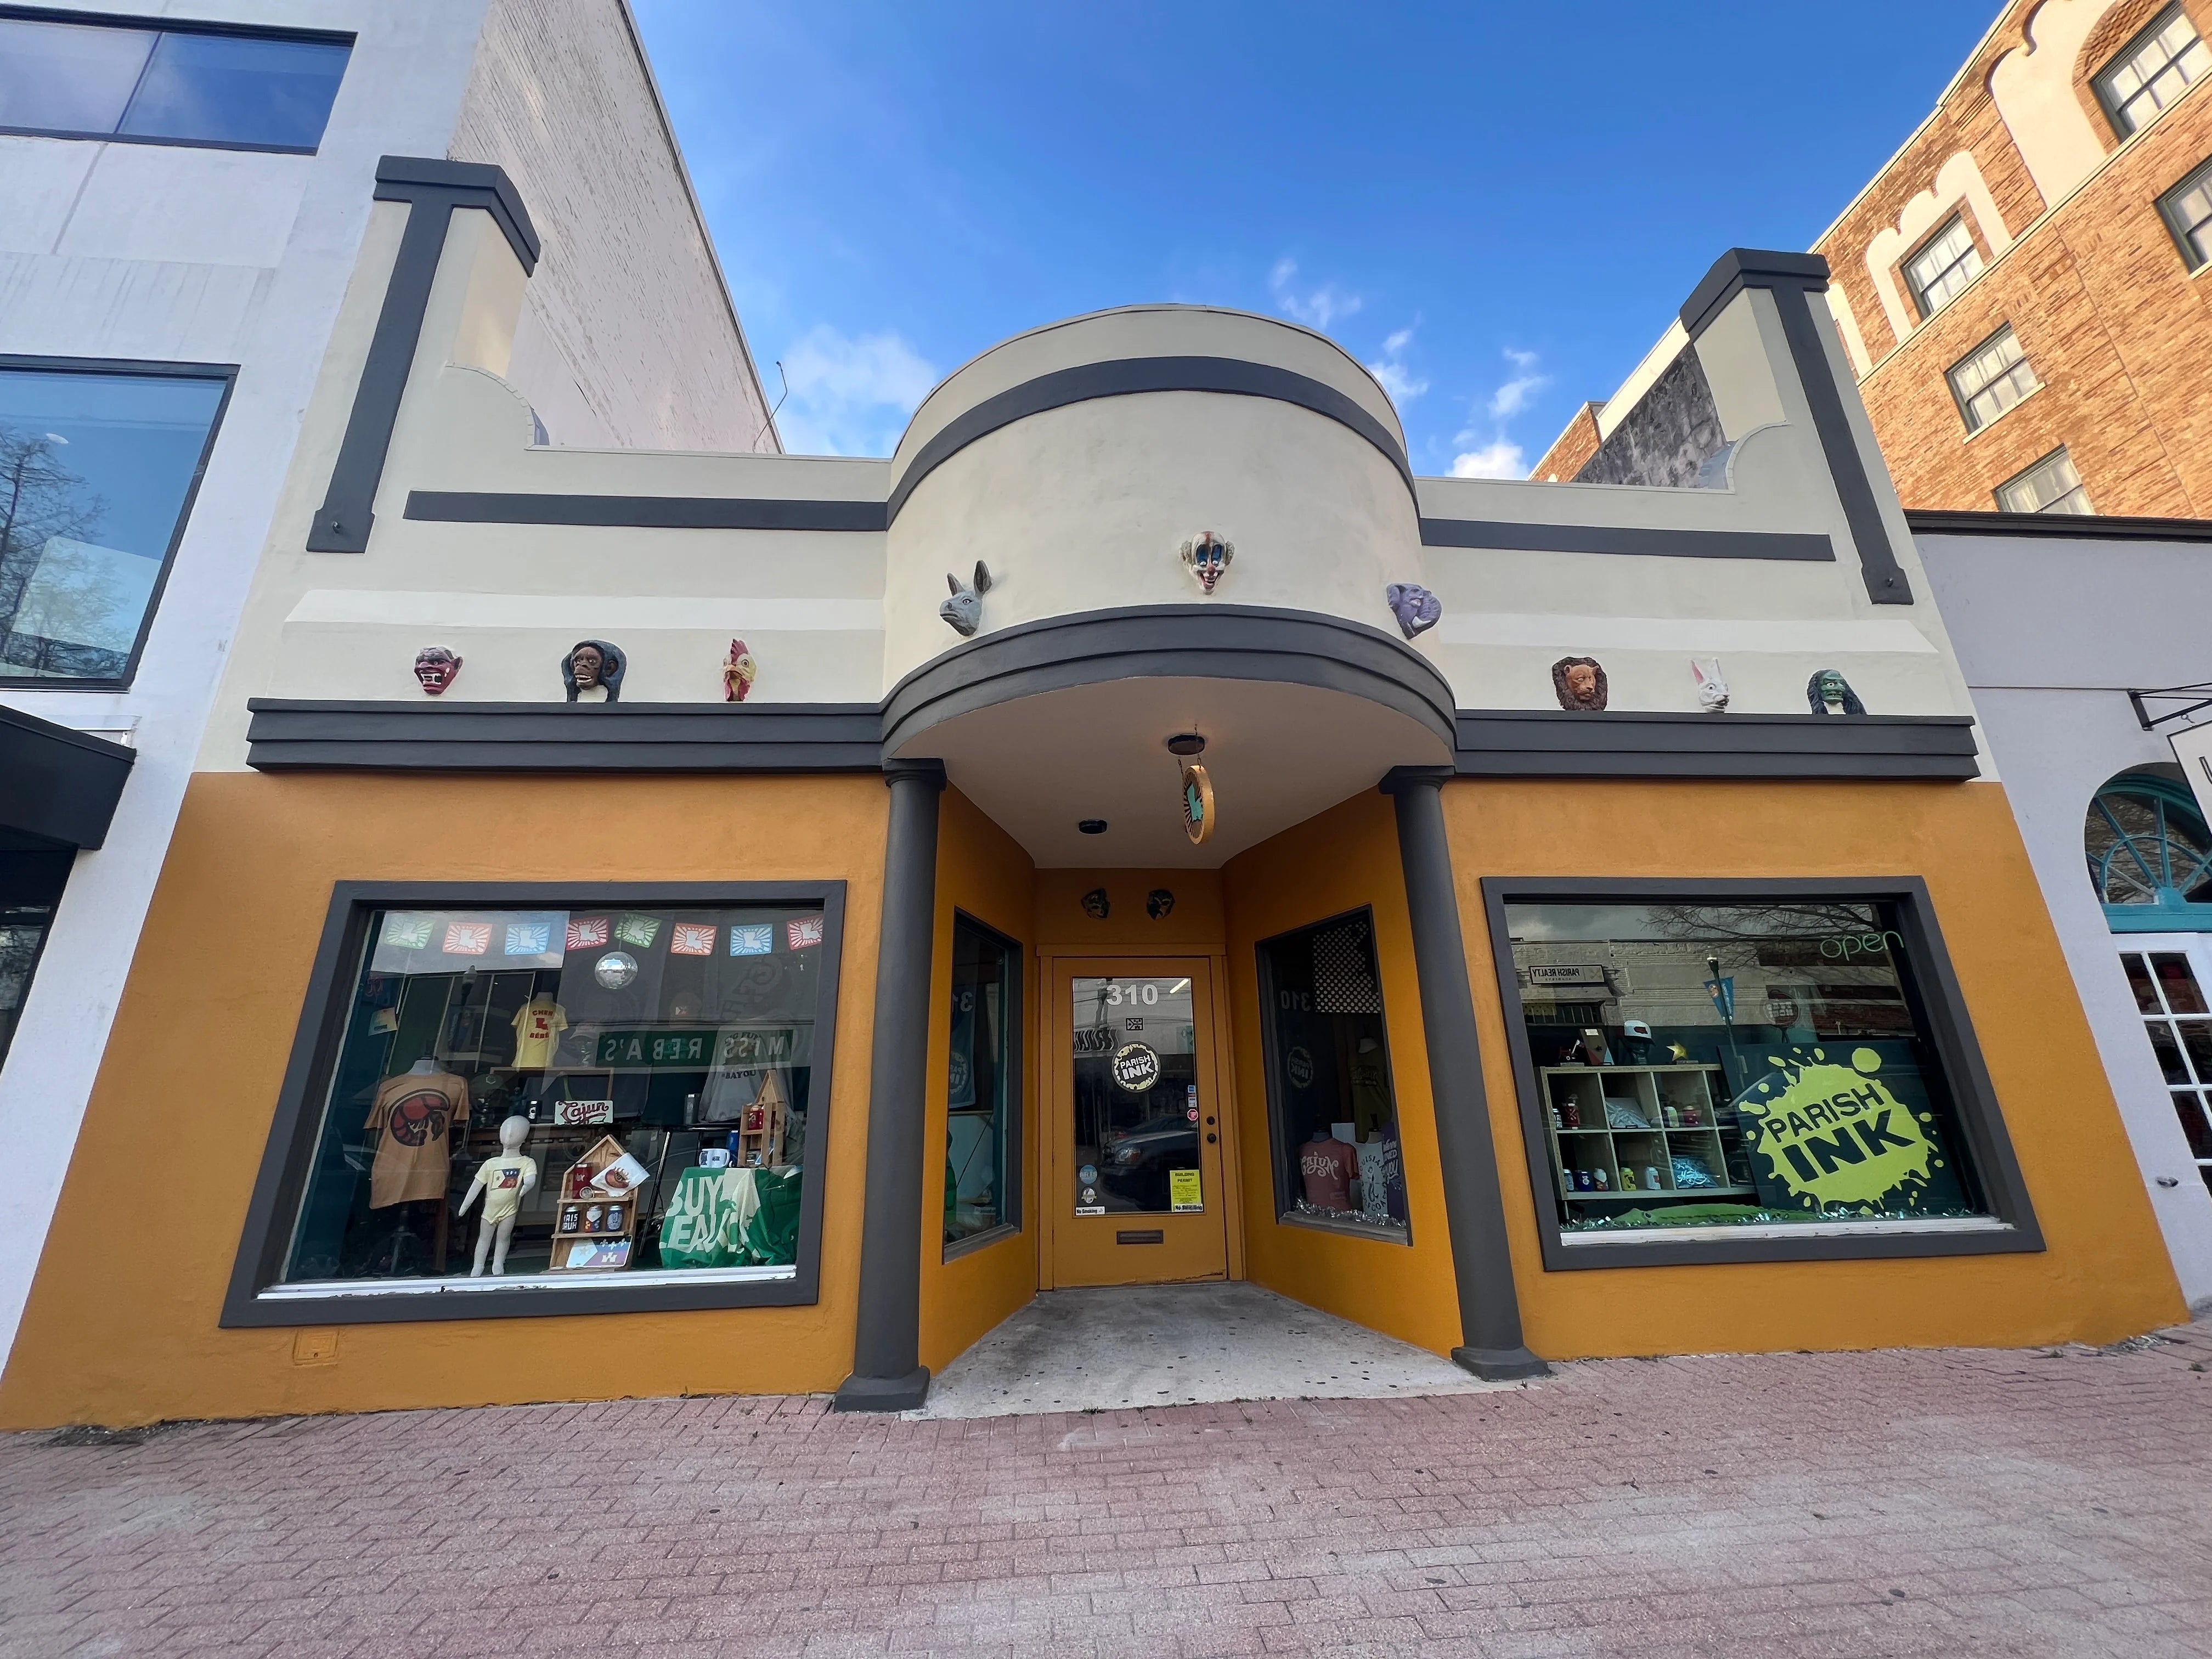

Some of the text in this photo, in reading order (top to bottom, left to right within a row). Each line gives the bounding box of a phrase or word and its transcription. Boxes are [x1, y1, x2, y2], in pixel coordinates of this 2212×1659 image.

[1820, 931, 1904, 961] open
[1107, 984, 1158, 1005] 310
[1120, 1055, 1151, 1069] PARISH
[1122, 1062, 1154, 1080] INK
[725, 1070, 757, 1079] BAYOU
[558, 1101, 609, 1123] Cajun
[1765, 1083, 1884, 1143] PARISH
[1782, 1109, 1916, 1183] INK
